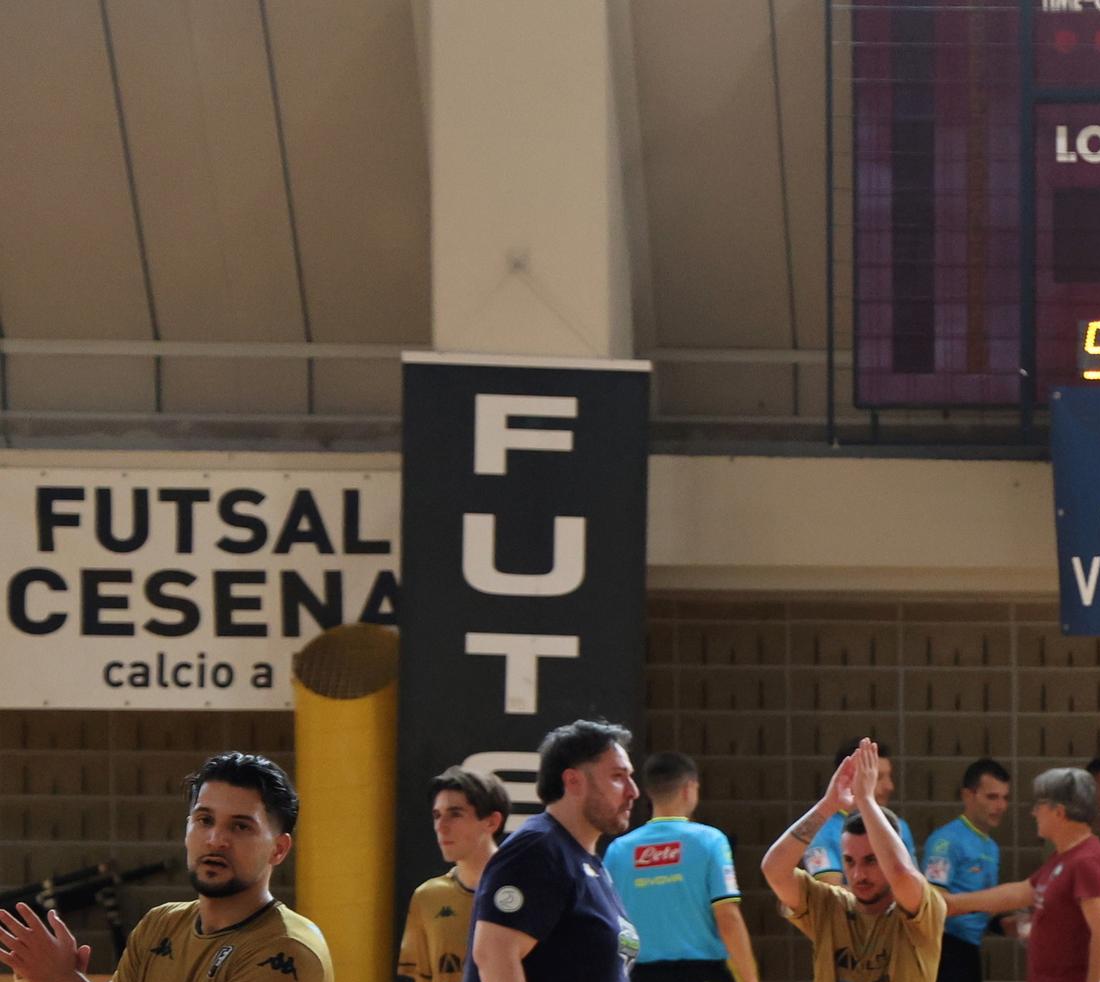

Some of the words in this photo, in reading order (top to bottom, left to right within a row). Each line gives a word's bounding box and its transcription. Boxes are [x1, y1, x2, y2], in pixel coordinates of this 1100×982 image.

[35, 486, 392, 555] FUTSAL
[103, 652, 235, 690] calcio
[250, 661, 274, 690] a
